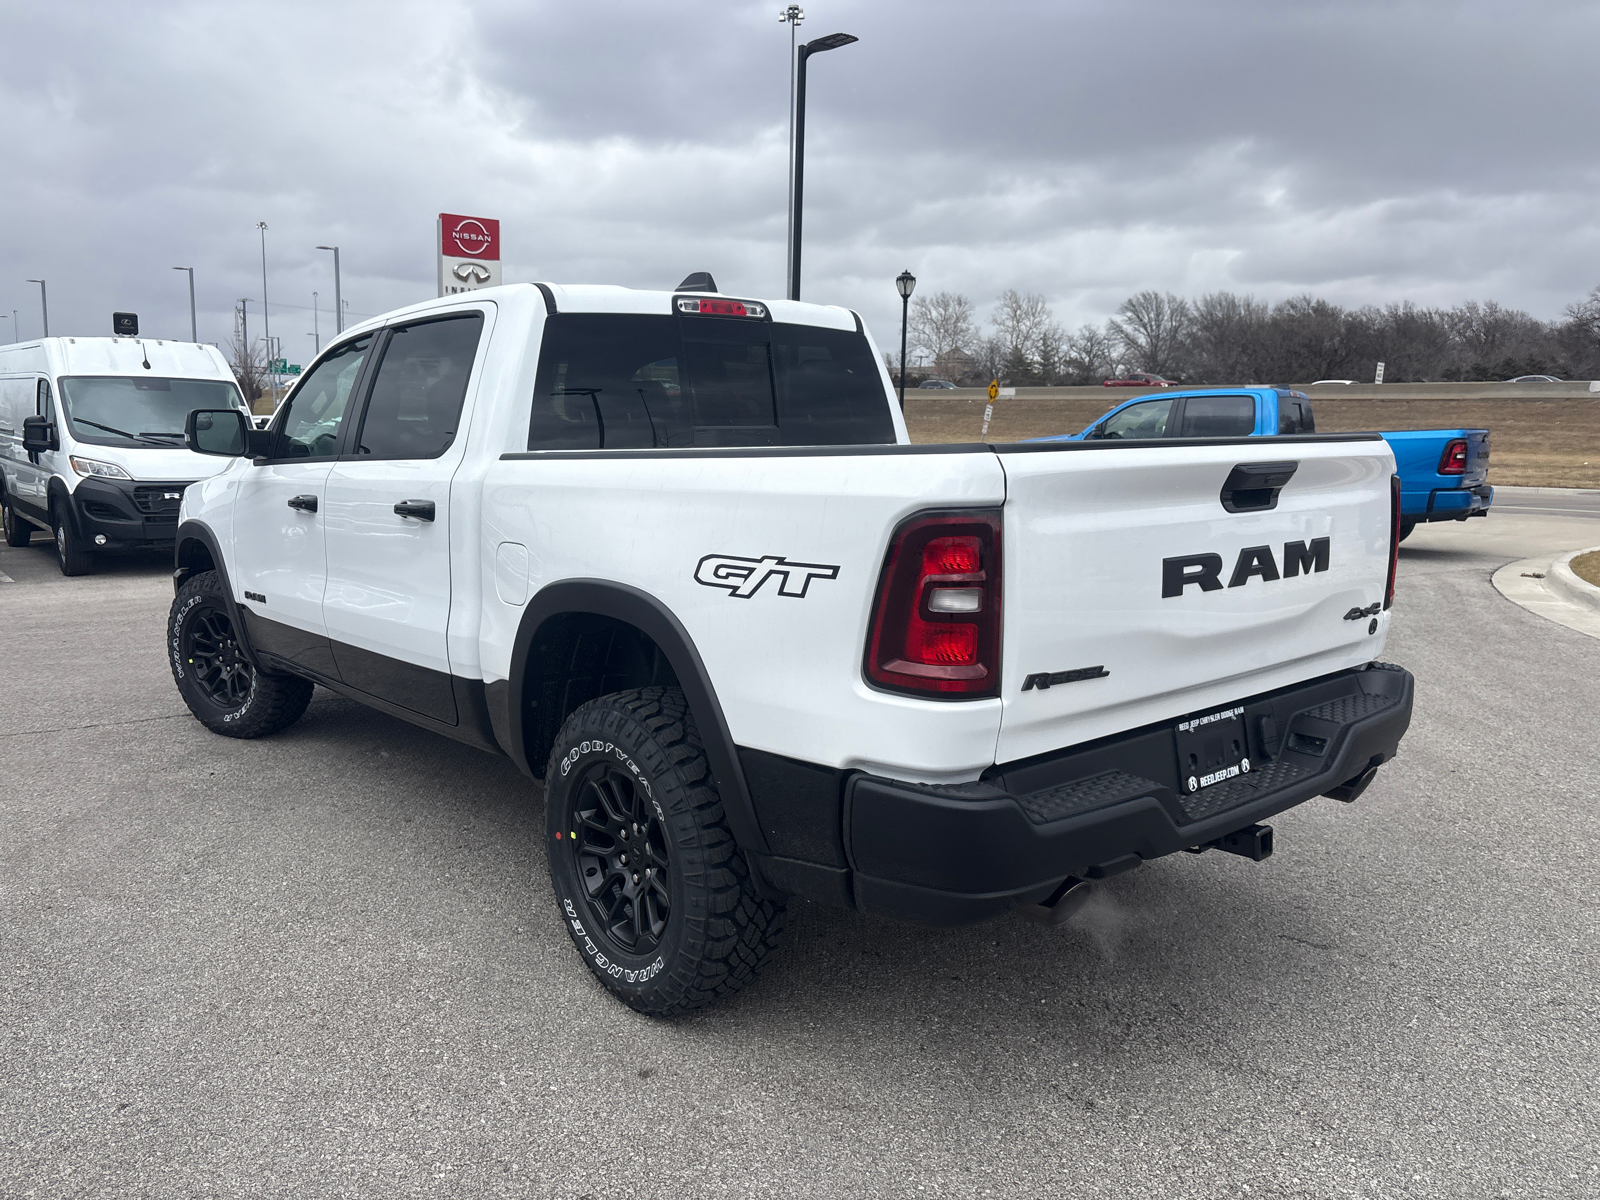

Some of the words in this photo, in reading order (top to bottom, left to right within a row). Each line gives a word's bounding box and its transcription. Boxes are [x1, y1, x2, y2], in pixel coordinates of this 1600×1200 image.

[452, 231, 491, 242] NISSAN
[1162, 536, 1330, 598] RAM
[173, 595, 202, 679] WRANGLER
[1021, 665, 1110, 691] REBEL
[560, 740, 665, 822] GOODYEAR
[1200, 765, 1239, 787] REEDJEEP.COM
[563, 898, 665, 983] WRANGLER
